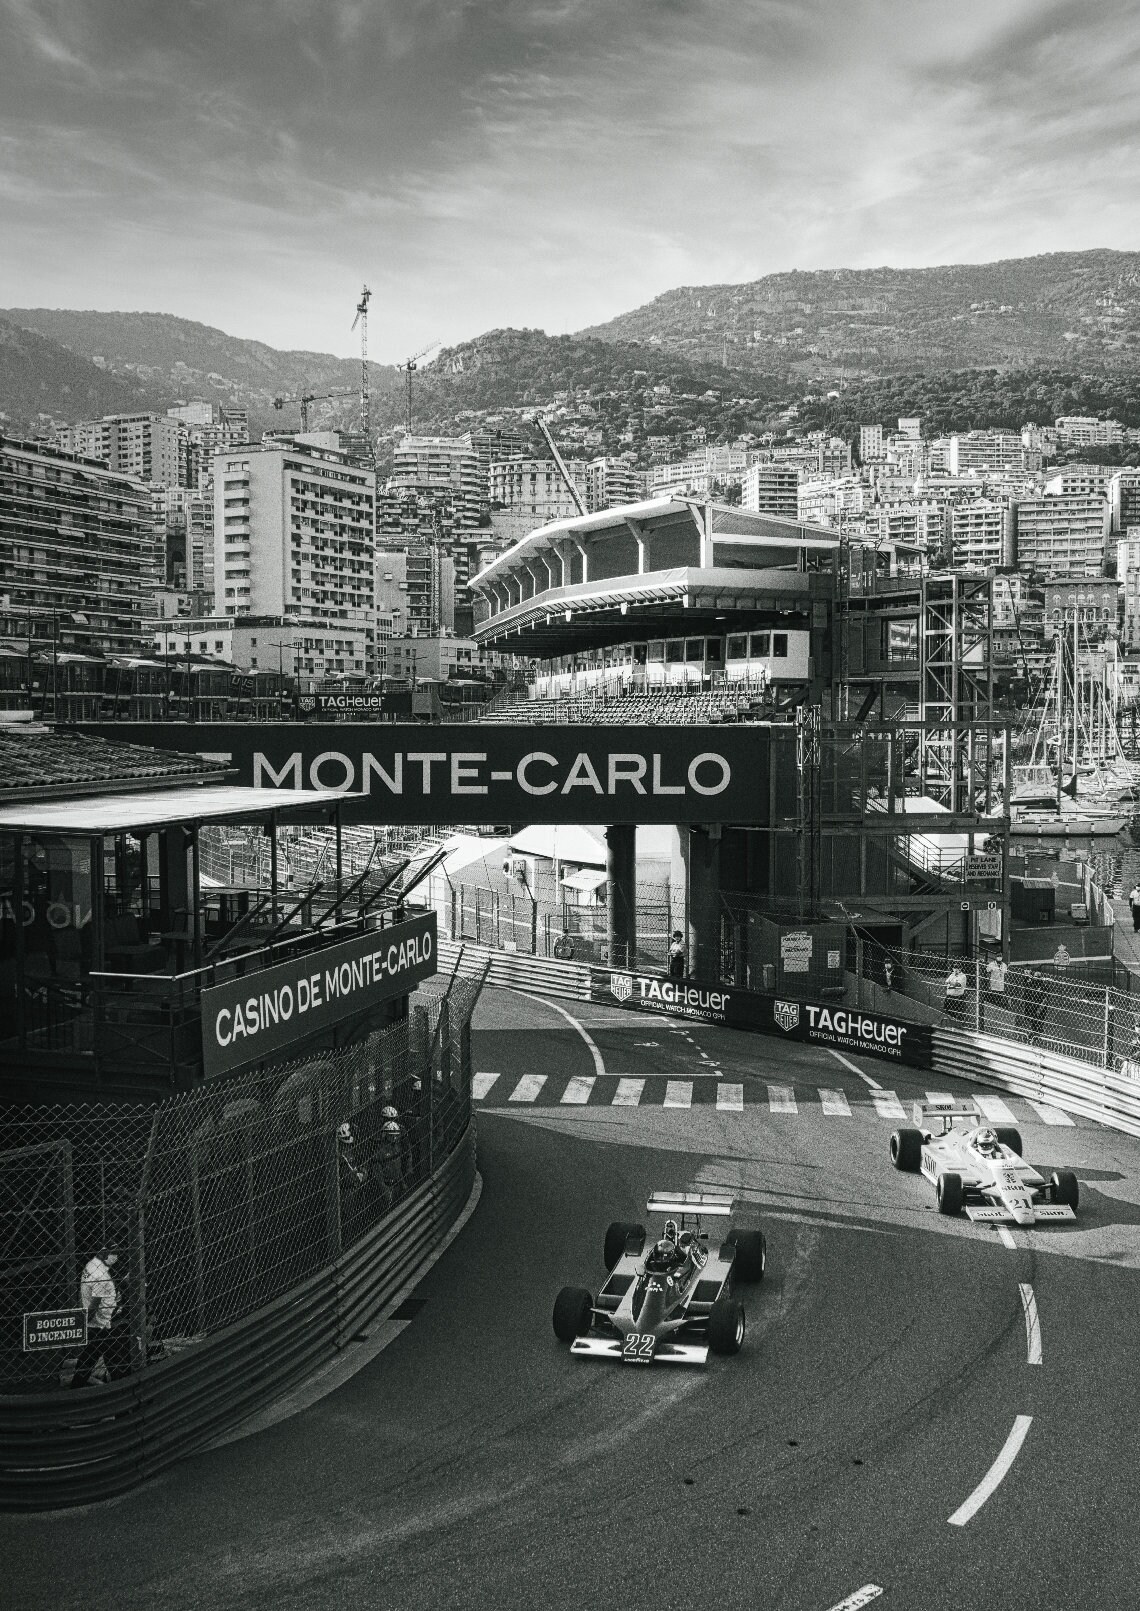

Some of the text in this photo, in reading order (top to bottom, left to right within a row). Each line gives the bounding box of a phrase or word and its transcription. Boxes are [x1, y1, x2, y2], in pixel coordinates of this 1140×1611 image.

[253, 752, 731, 795] MONTE-CARLO
[613, 975, 630, 986] TAG
[215, 931, 432, 1047] CASINO DE MONTE-CARLO
[665, 1004, 686, 1013] WATCH
[776, 1002, 797, 1015] TAG
[775, 1013, 798, 1030] HEUER
[809, 1030, 901, 1057] OFFICIAL WATCH MONACO GPH
[1008, 1198, 1032, 1211] 21
[36, 1317, 76, 1330] BOUCHE
[623, 1333, 656, 1357] 22
